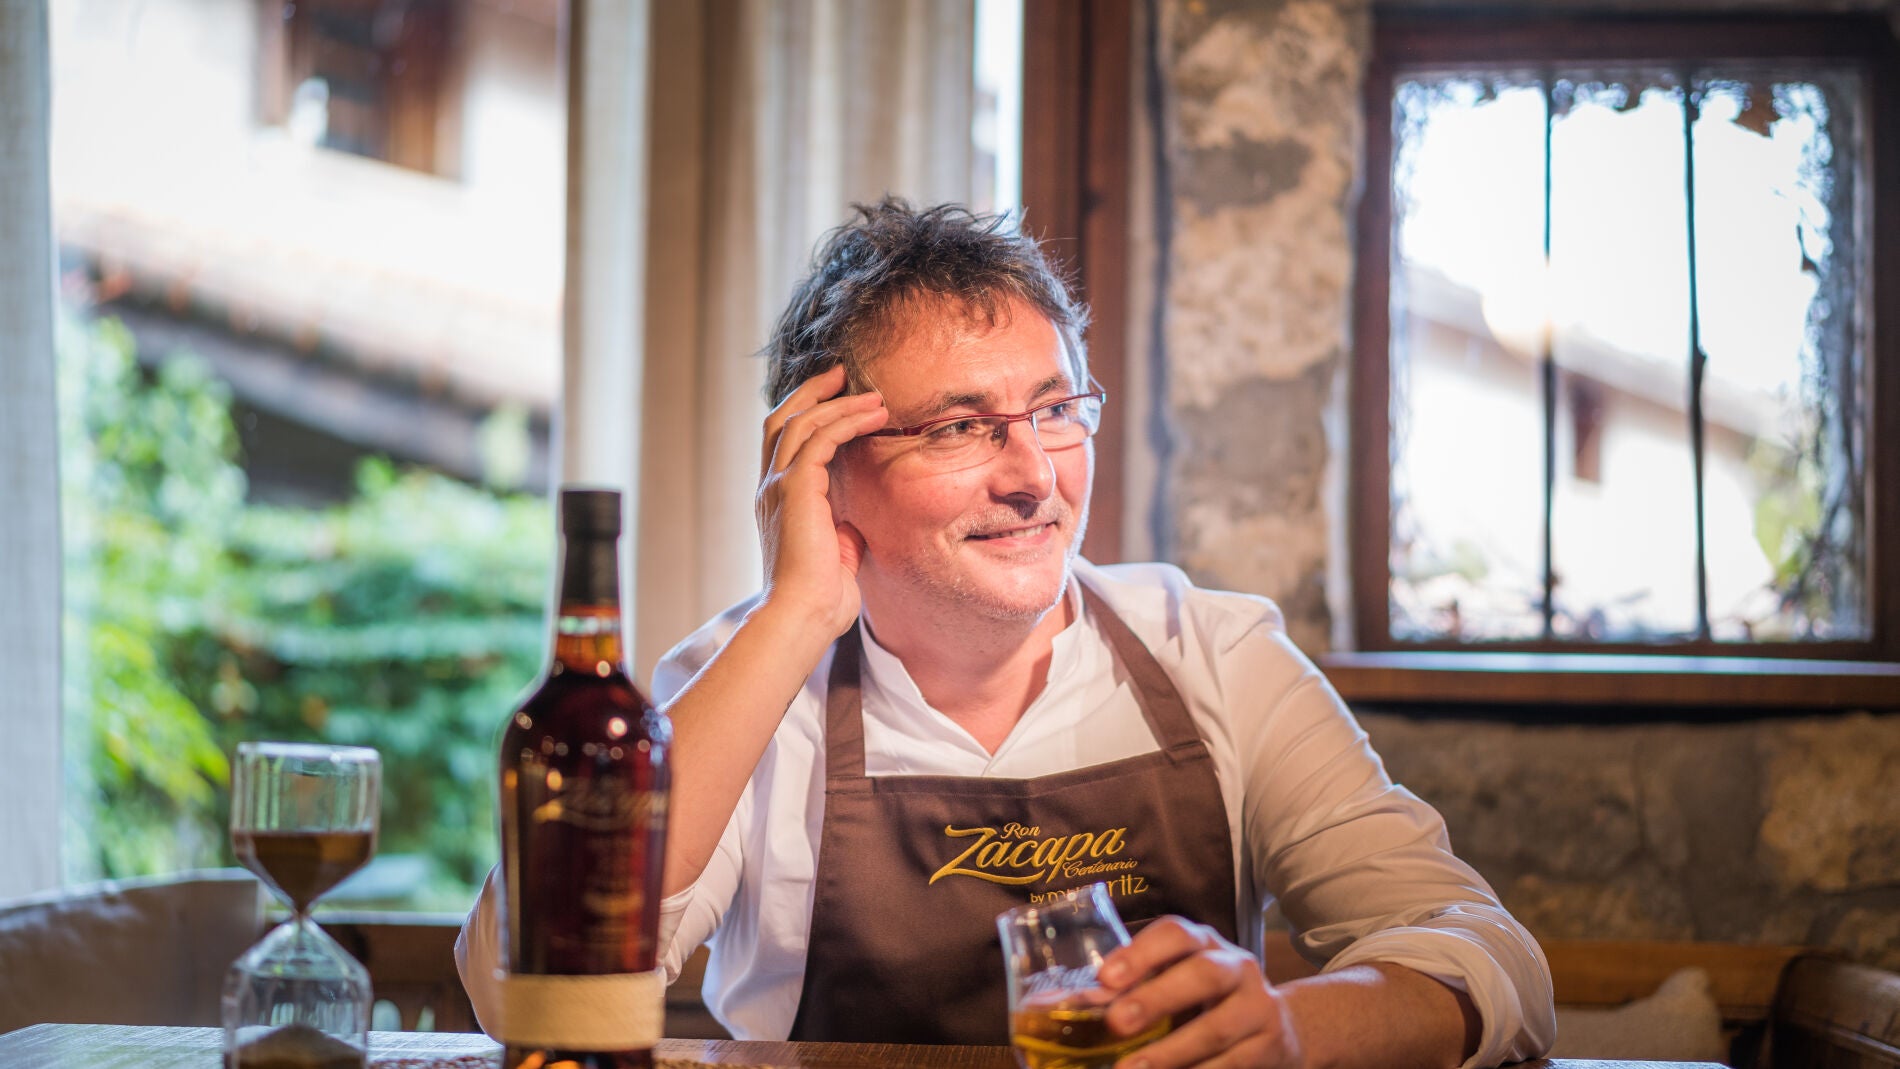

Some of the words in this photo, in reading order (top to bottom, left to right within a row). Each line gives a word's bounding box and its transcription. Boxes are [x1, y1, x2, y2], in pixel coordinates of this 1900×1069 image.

[1000, 822, 1040, 840] Ron
[928, 824, 1127, 886] Zacapa
[1062, 857, 1138, 879] Centenario
[1030, 892, 1045, 905] by
